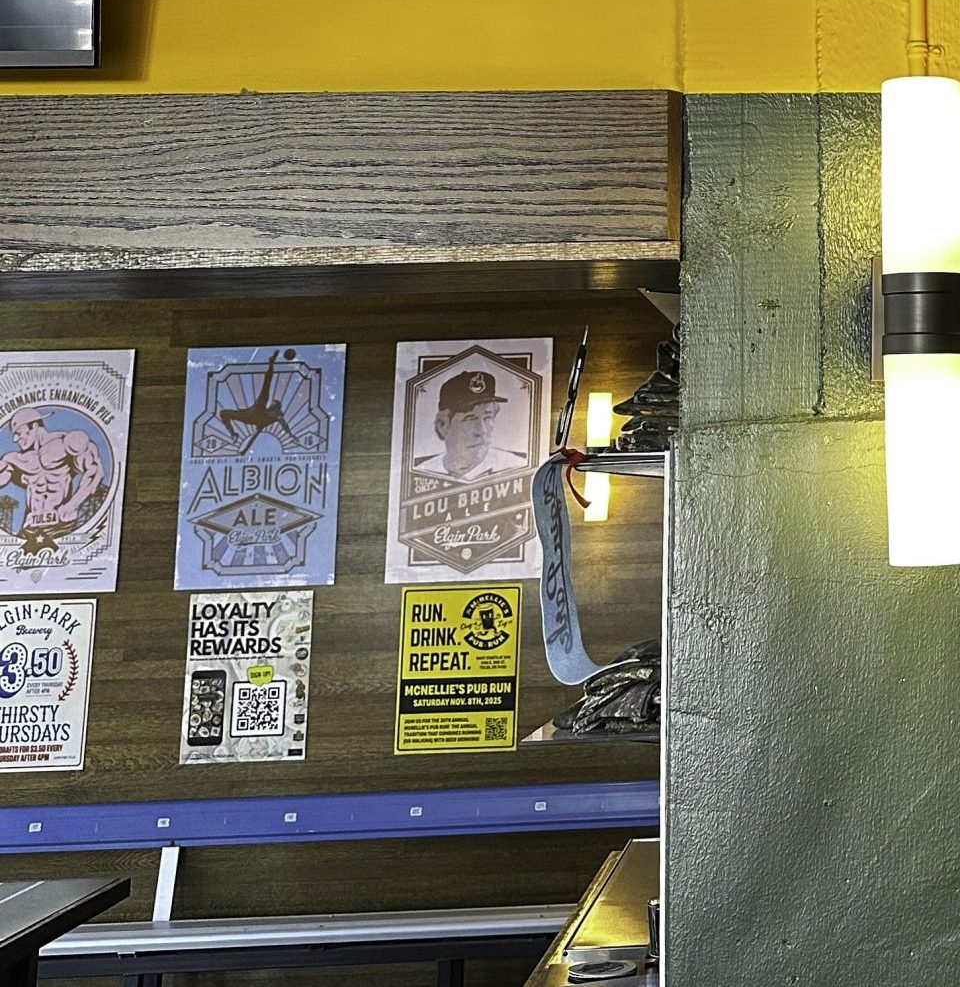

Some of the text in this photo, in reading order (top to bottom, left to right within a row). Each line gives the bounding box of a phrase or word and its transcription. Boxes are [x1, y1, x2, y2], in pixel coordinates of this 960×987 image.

[0, 388, 115, 426] FORMANCE ENHANCING PILS
[187, 462, 328, 515] ALBION
[412, 478, 523, 520] LOU BROWN
[32, 512, 57, 524] TULSA
[232, 508, 277, 527] ALE
[445, 502, 490, 522] ALE
[433, 524, 501, 551] Elgin Park
[6, 549, 71, 574] Elgin Park
[40, 604, 81, 635] PARK
[191, 601, 276, 621] LOYALTY
[411, 603, 447, 623] RUN.
[15, 624, 53, 641] Brewery
[191, 620, 260, 639] HAS ITS
[410, 627, 462, 648] DRINK.
[190, 637, 282, 657] REWARDS
[0, 642, 63, 699] 3.50
[409, 651, 472, 672] REPEAT.
[404, 682, 512, 697] MCNELLIE'S PUB RUN
[413, 698, 450, 707] SATURDAY
[450, 697, 468, 706] NOV.
[484, 696, 502, 705] 2025
[0, 704, 60, 724] HIRSTY
